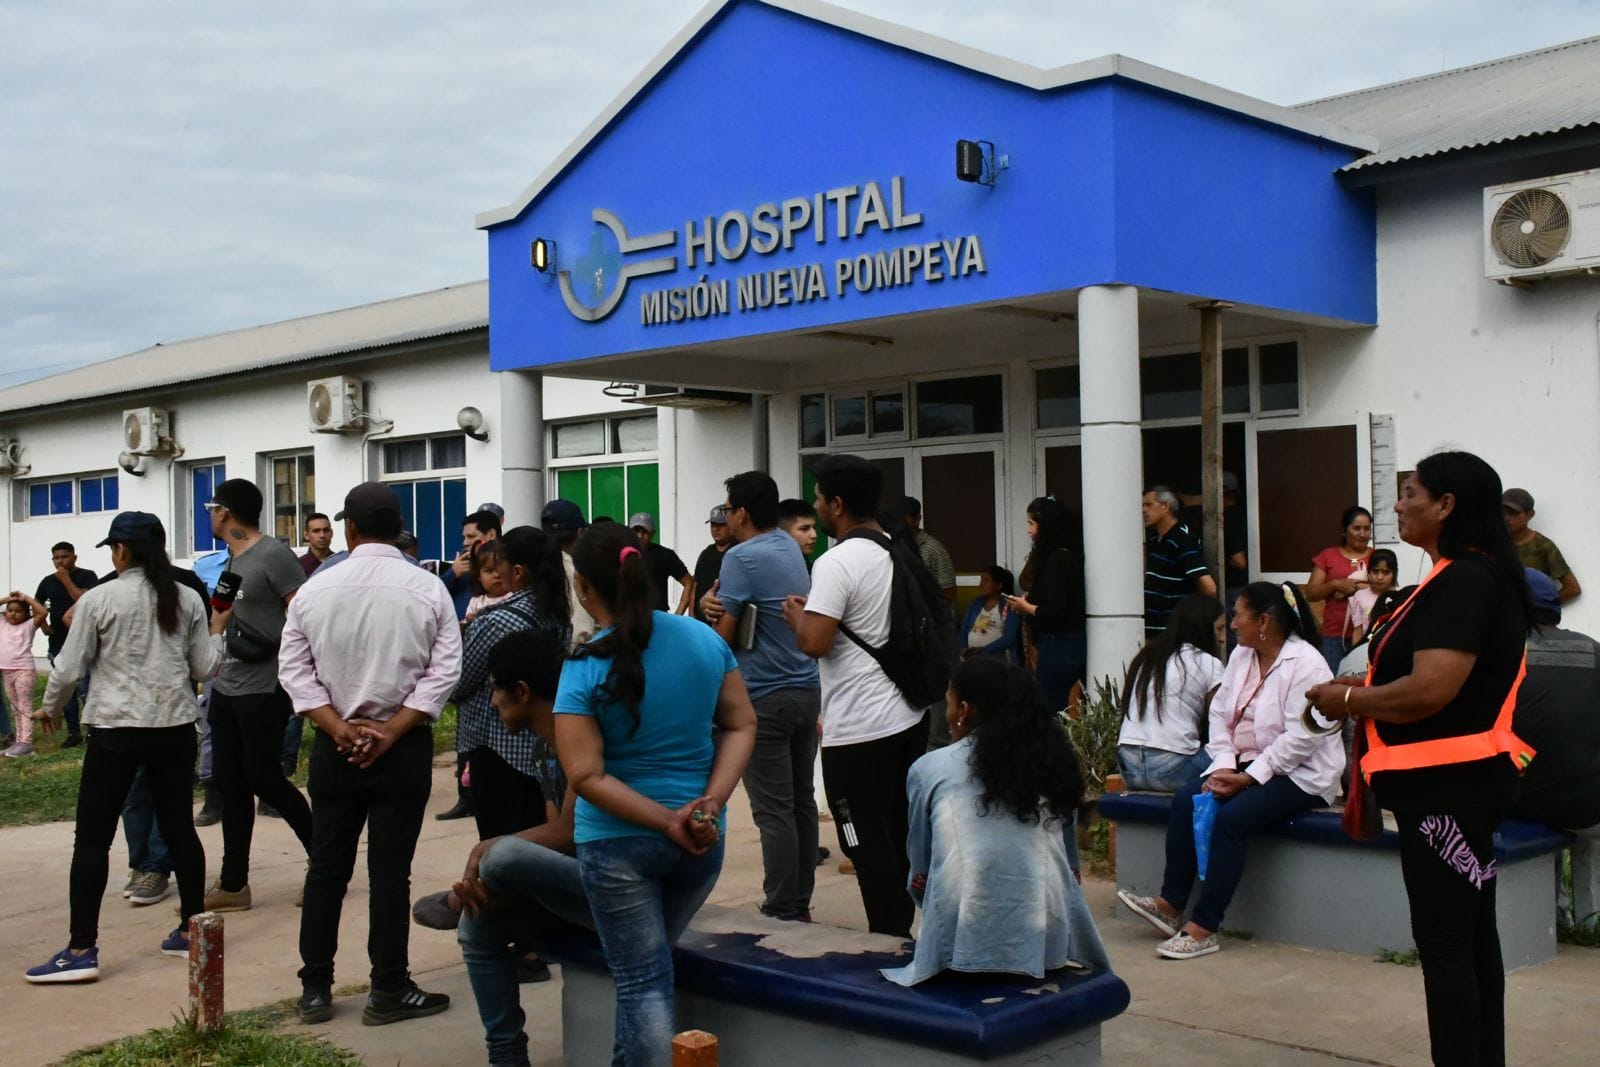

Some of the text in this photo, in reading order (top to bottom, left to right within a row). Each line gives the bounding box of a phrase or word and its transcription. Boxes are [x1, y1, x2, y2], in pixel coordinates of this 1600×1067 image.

[685, 176, 923, 267] HOSPITAL
[640, 235, 986, 325] MISIÓN NUEVA POMPEYA
